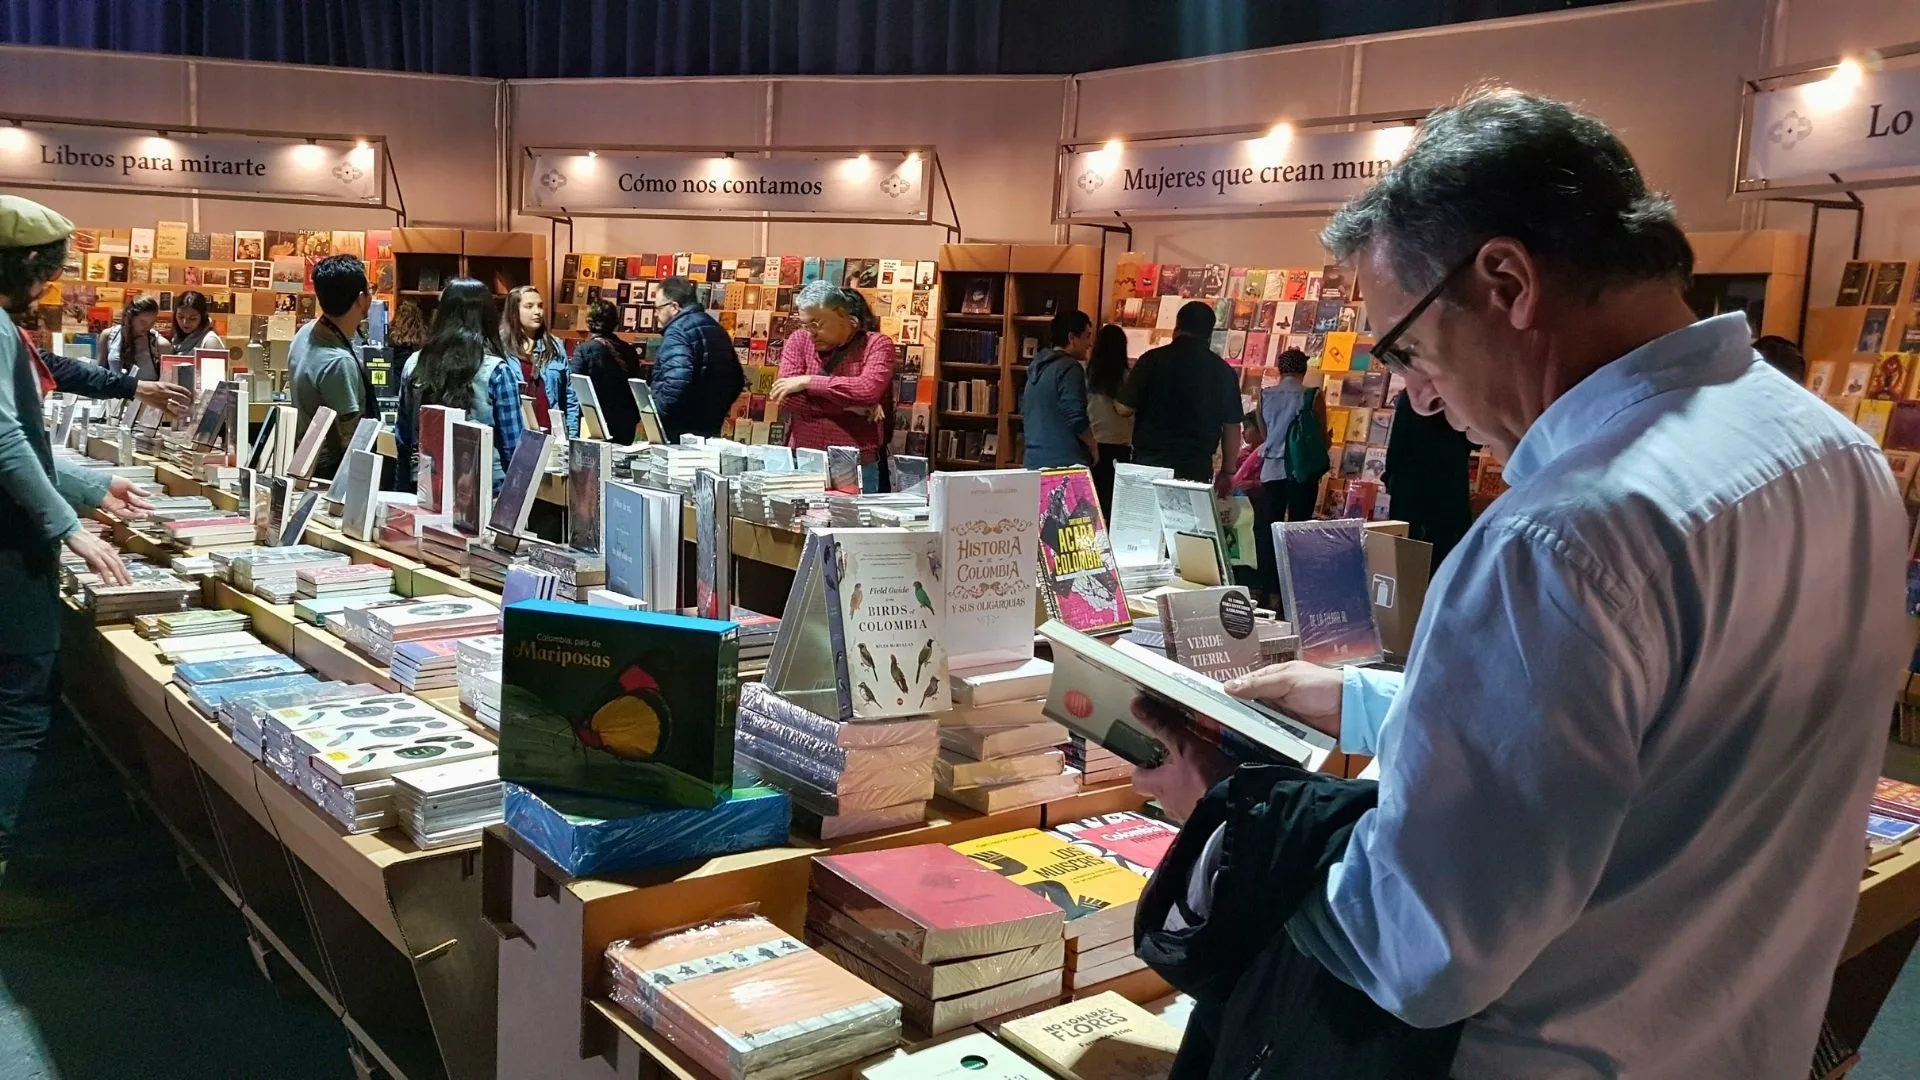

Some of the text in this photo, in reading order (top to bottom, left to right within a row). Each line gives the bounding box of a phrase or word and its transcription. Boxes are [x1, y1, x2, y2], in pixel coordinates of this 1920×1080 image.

[1866, 103, 1914, 138] Lo
[40, 144, 266, 176] Libros para mirarte
[618, 173, 823, 196] Cómo nos contamos
[1123, 165, 1206, 197] Mujeres
[1212, 167, 1253, 195] que
[1260, 162, 1325, 184] crean
[957, 535, 1023, 562] HISTORIA
[957, 561, 1020, 583] COLOMBIA
[1054, 549, 1104, 576] COLOMBIA
[869, 585, 910, 596] Field Guide
[868, 604, 908, 617] BIRDS
[951, 604, 957, 614] Y
[959, 602, 975, 613] SUS
[858, 619, 928, 632] COLOMBIA
[1186, 634, 1224, 650] VERDE
[512, 640, 612, 669] Mariposas
[1190, 651, 1232, 668] TIERRA
[1049, 846, 1086, 861] LOS
[1032, 854, 1105, 880] MUISCAS
[1041, 1021, 1063, 1034] NO
[1050, 1012, 1129, 1042] FLORES
